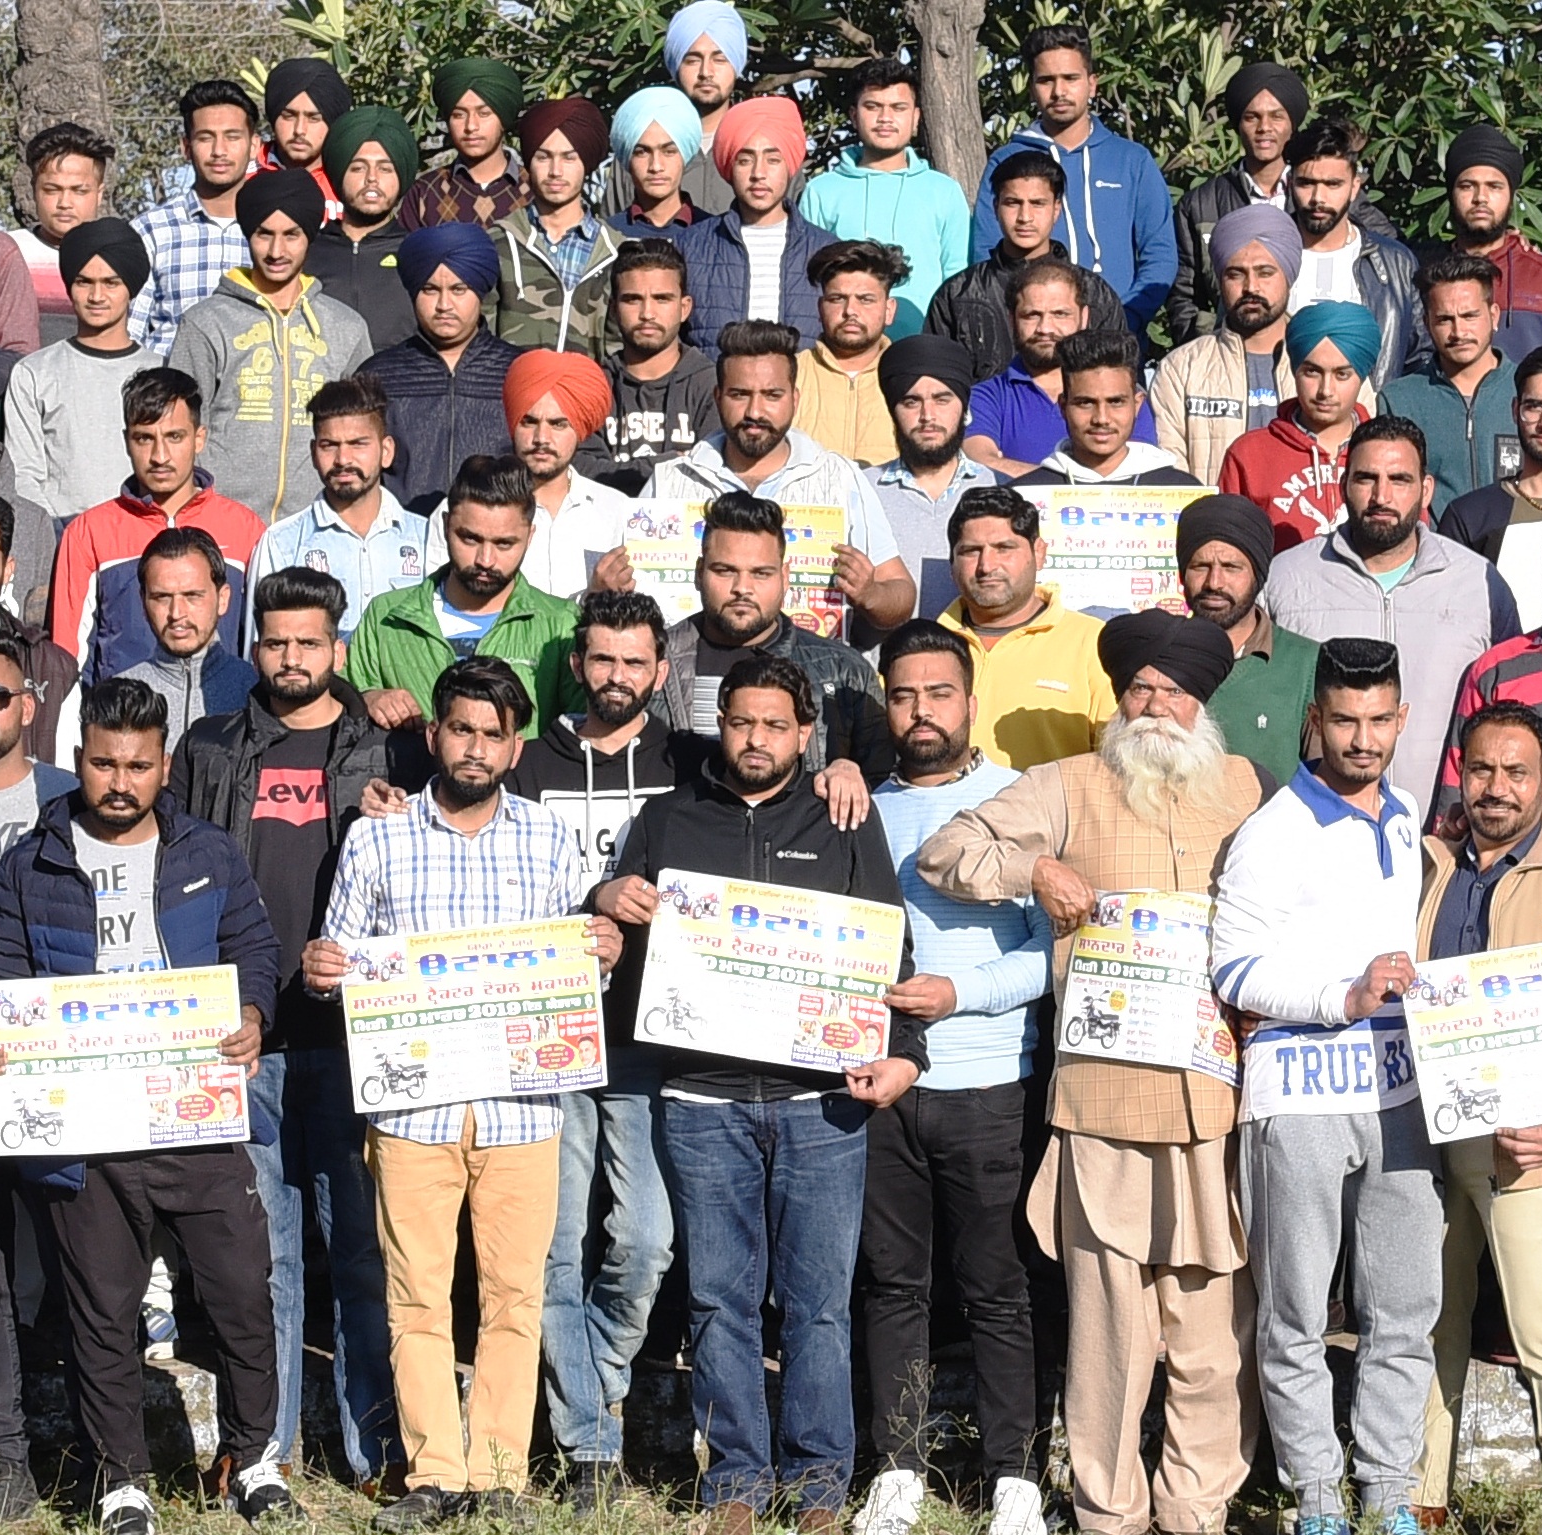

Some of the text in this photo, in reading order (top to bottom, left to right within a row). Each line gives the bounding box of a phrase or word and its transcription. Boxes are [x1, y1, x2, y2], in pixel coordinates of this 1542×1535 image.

[1190, 400, 1241, 418] ILIPP
[1099, 556, 1146, 569] 2019
[663, 570, 687, 582] 10
[767, 966, 819, 985] 2019
[1101, 961, 1121, 975] 10
[391, 1014, 418, 1028] 10
[469, 1001, 521, 1019] 2019
[32, 1061, 57, 1074] 10
[109, 1052, 161, 1068] 2019
[1276, 1042, 1373, 1097] TRUE
